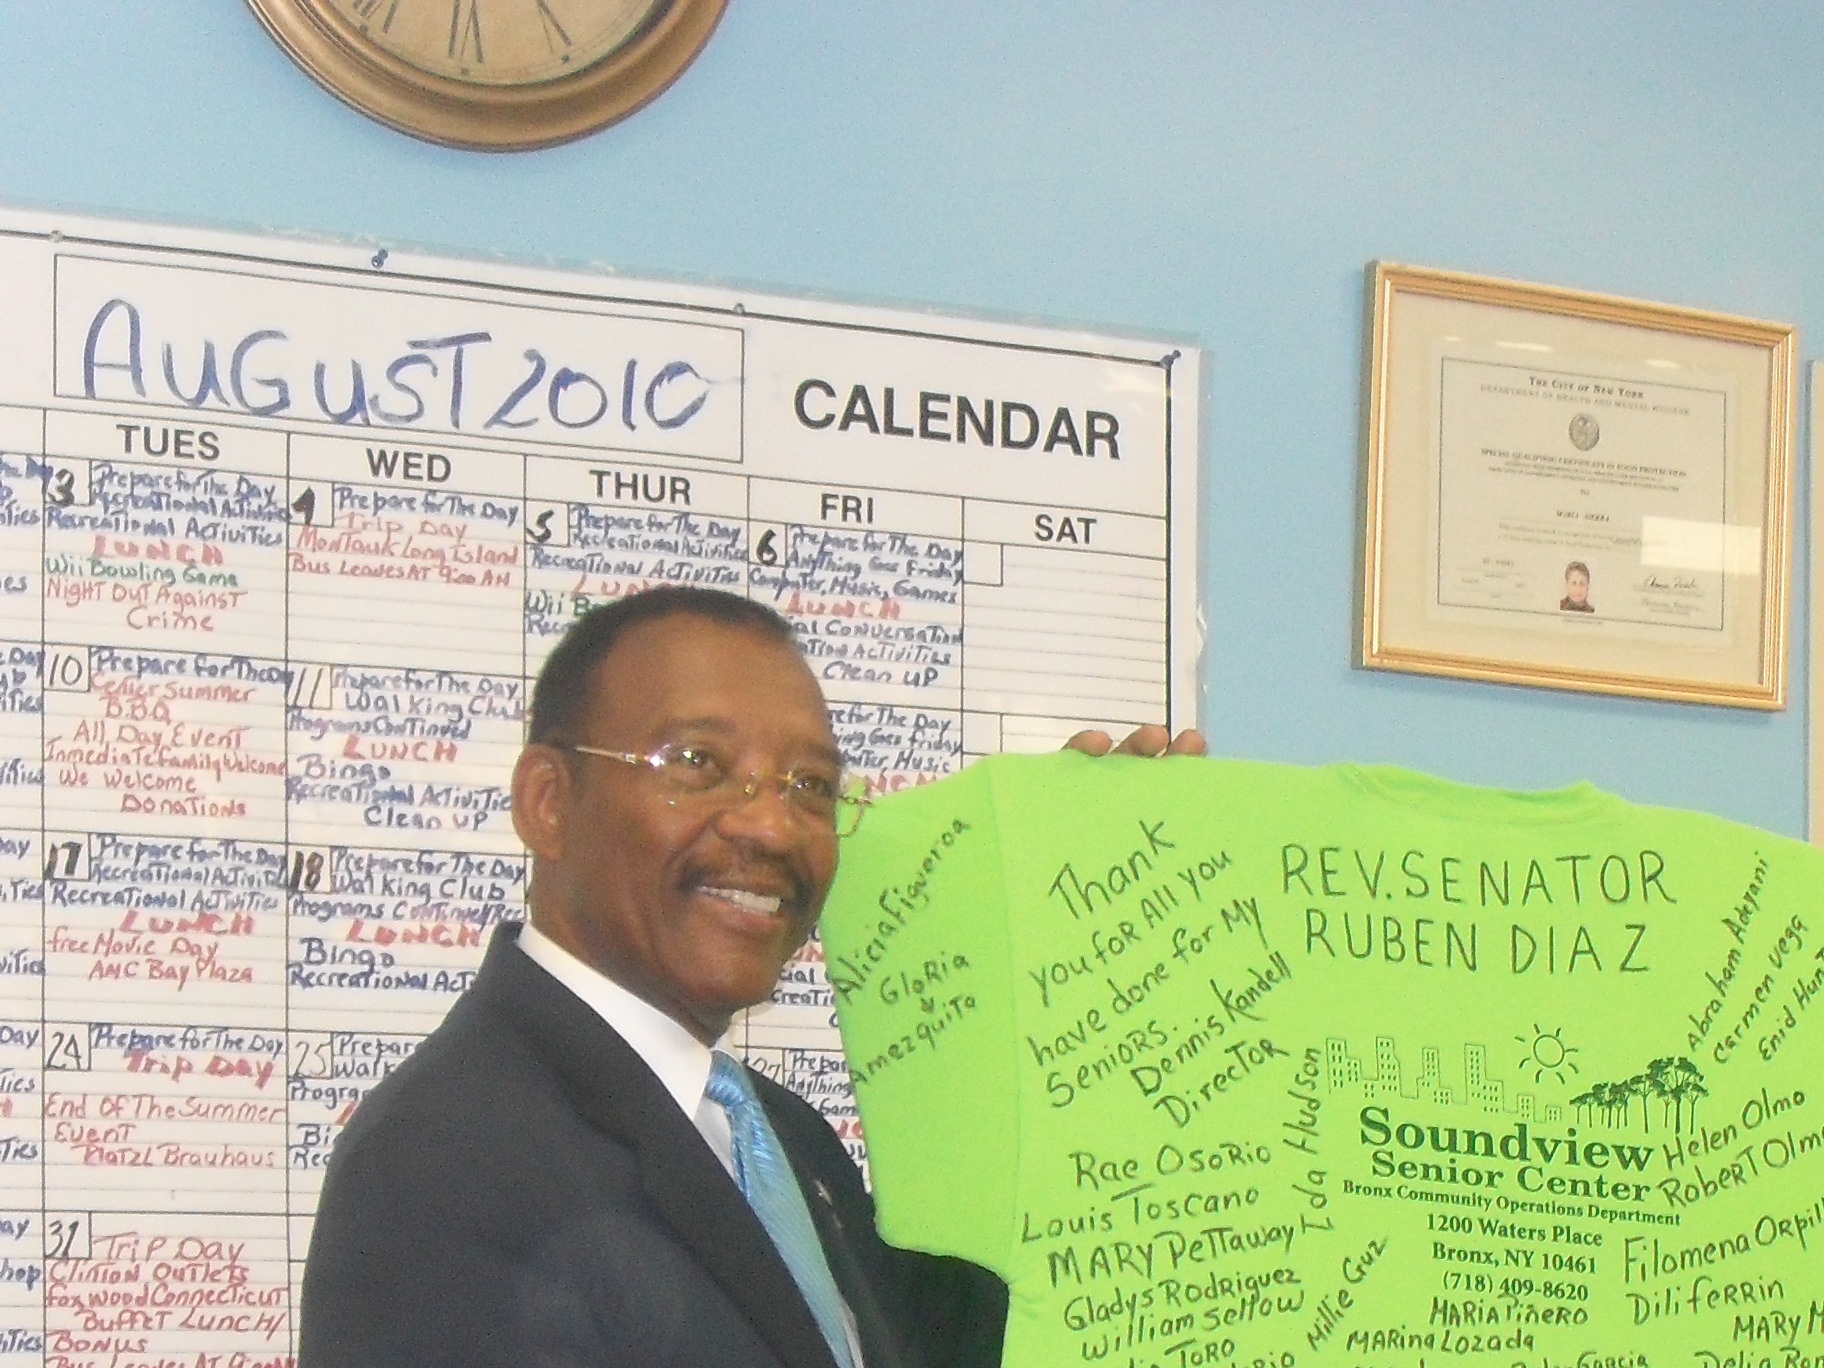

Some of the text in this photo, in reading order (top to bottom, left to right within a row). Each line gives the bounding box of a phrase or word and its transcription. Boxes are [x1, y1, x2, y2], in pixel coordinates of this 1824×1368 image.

[483, 347, 709, 431] 2010
[792, 377, 1121, 460] CALENDAR
[116, 423, 220, 461] TUES
[366, 448, 452, 484] WED
[48, 469, 75, 507] 3
[588, 469, 692, 506] THUR
[525, 509, 555, 543] 5
[819, 494, 875, 526] FRI
[1034, 513, 1099, 546] SAT
[92, 534, 225, 566] LUNCH
[290, 550, 330, 575] Bus
[756, 529, 777, 566] 6
[49, 653, 83, 687] 10
[117, 722, 163, 753] Day
[342, 733, 459, 763] LUNCH
[297, 753, 392, 787] Bingo
[288, 850, 324, 892] 18
[1048, 820, 1176, 920] Thank
[1281, 843, 1678, 907] REV. SENATOR
[1305, 908, 1650, 975] RUBEN DIAZ
[1026, 1007, 1109, 1068] have
[1107, 961, 1170, 1017] done
[1130, 949, 1293, 1098] Dennis Kandell
[47, 1031, 83, 1072] 24
[1358, 1105, 1654, 1173] Soundview
[1663, 1086, 1806, 1171] Helen Olmo
[1068, 1150, 1139, 1191] Rae
[1372, 1150, 1652, 1203] Senior Center
[1342, 1179, 1682, 1228] Bronx Community Operations Department
[44, 1220, 79, 1260] 31
[1020, 1206, 1115, 1244] Louis
[1427, 1213, 1604, 1247] 1200 Waters Place
[1046, 1240, 1155, 1289] MARY
[1431, 1241, 1597, 1275] Bronx, NY 10461
[1622, 1233, 1751, 1284] Filomena
[1441, 1270, 1590, 1302] (718) 409-8620
[1063, 1285, 1155, 1332] Gladys
